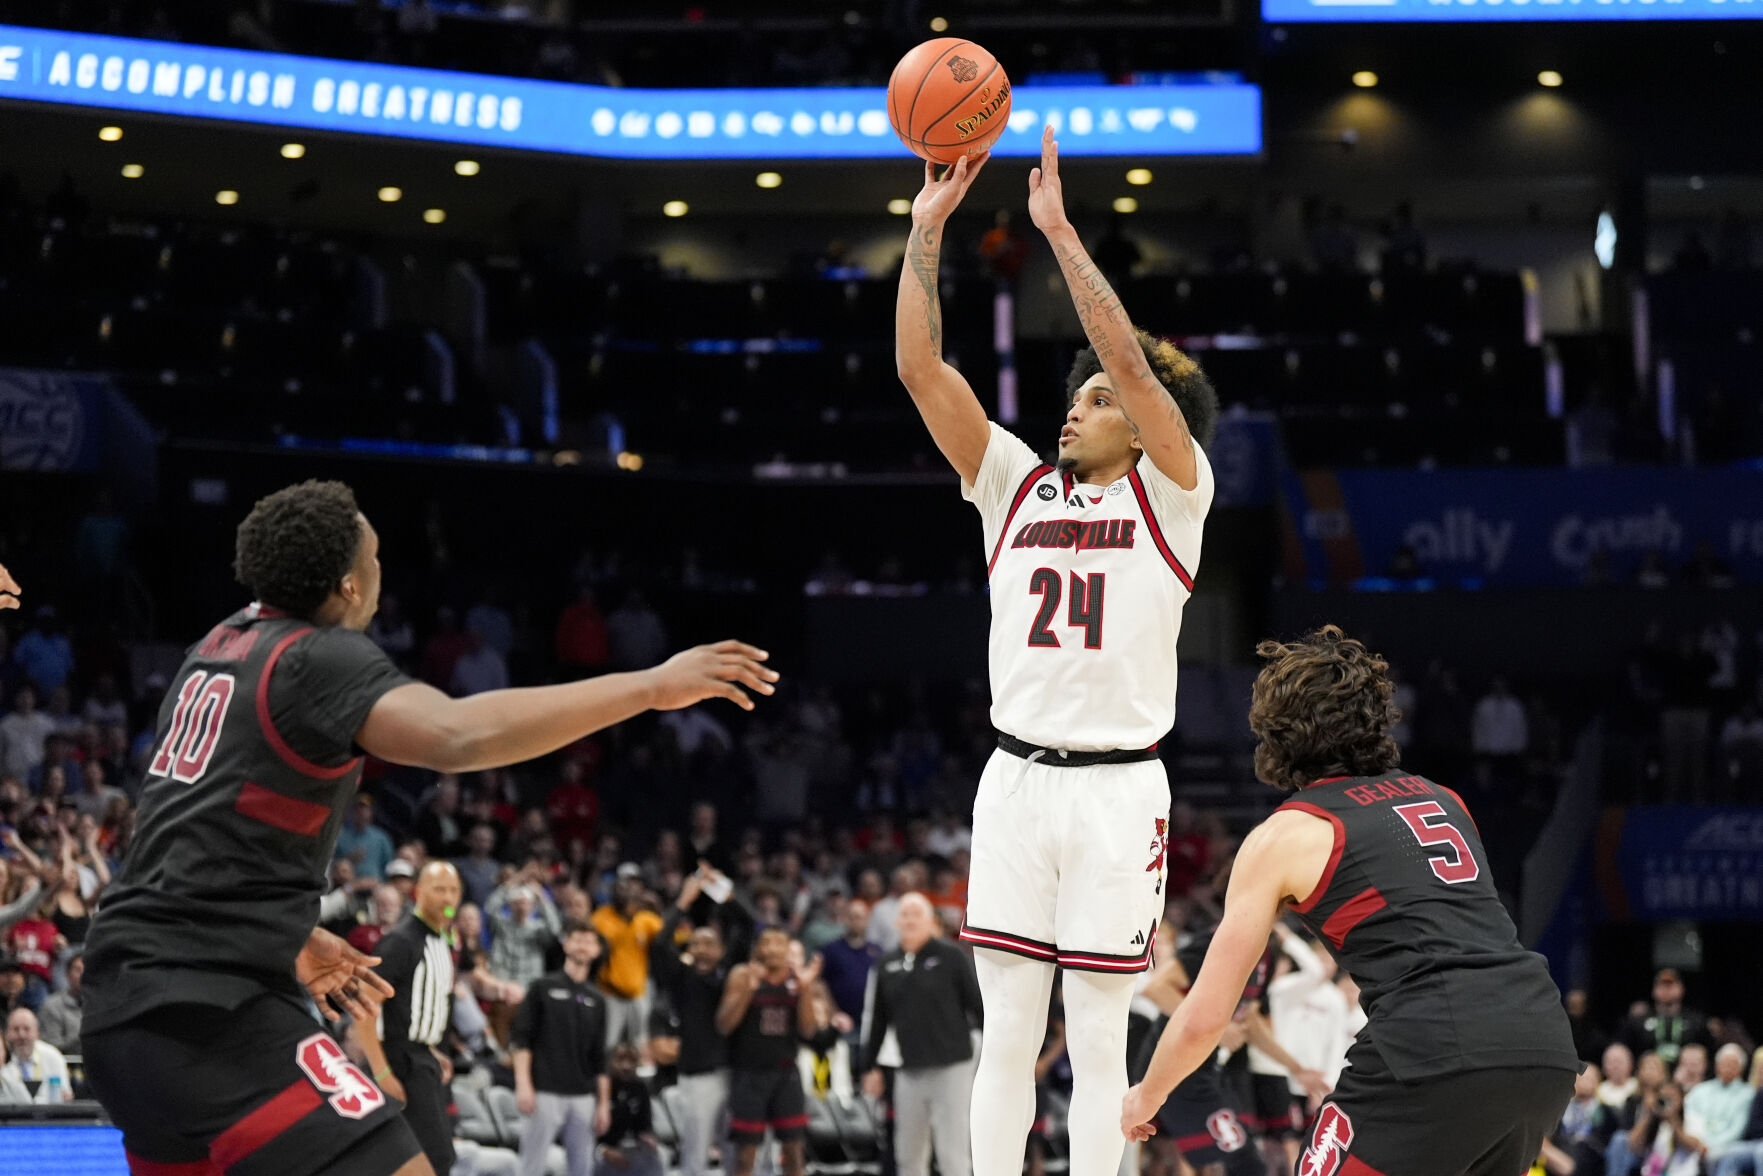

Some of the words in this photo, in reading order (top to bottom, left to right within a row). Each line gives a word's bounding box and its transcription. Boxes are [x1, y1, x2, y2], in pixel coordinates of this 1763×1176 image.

[49, 50, 296, 110] ACCOMPLISH
[312, 76, 523, 132] GREATNESS
[1039, 485, 1056, 498] JB
[1011, 519, 1136, 554] LOUISVILLE
[1404, 506, 1515, 571] ally
[1027, 566, 1106, 651] 24
[148, 668, 236, 785] 10
[1344, 776, 1436, 806] GEALER
[1391, 800, 1480, 885] 5
